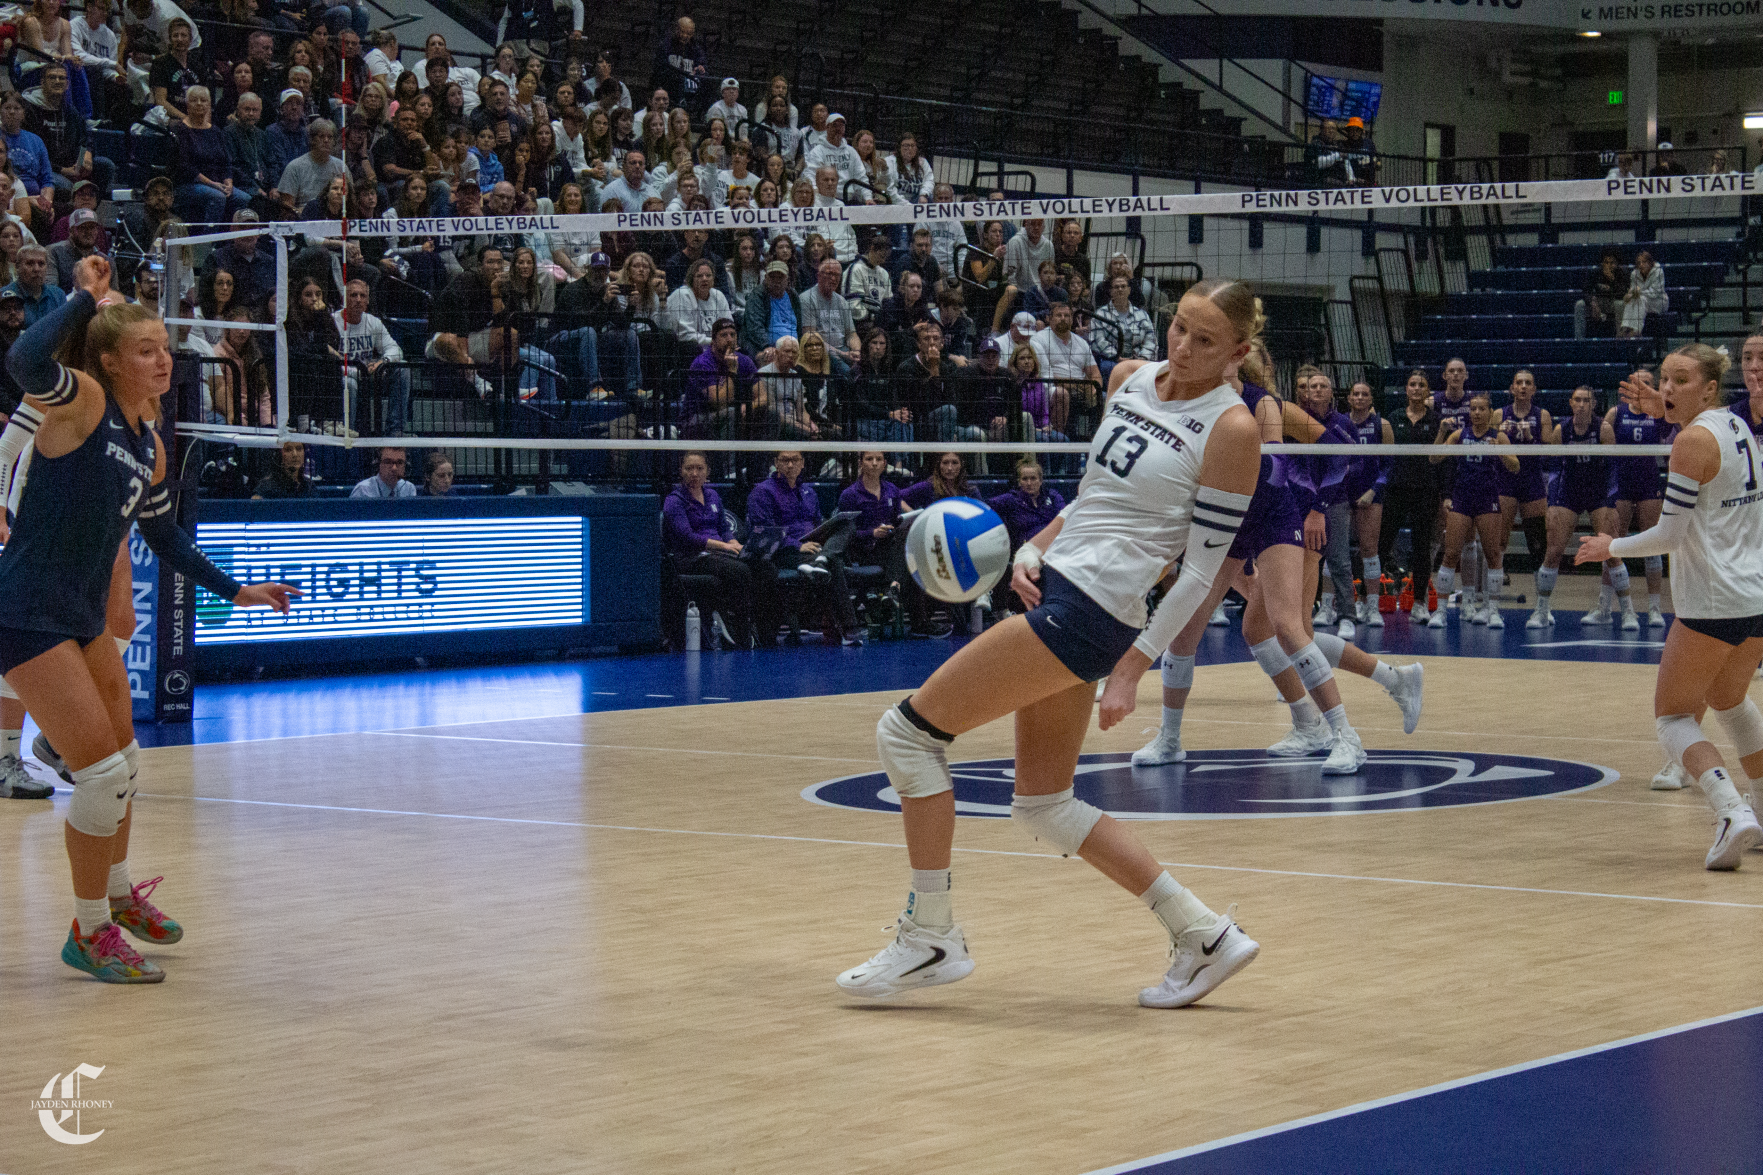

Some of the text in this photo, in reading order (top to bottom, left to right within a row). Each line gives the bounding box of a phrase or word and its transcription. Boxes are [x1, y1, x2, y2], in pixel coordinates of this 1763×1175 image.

[1599, 1, 1761, 20] MEN'S RESTROOM
[1241, 183, 1528, 208] PENN STATE VOLLEYBALL
[1607, 174, 1755, 196] PENN STATE
[618, 207, 850, 228] PENN STATE VOLLEYBALL
[914, 196, 1171, 219] PENN STATE VOLLEYBALL
[348, 215, 560, 233] PENN STATE VOLLEYBALL
[1110, 403, 1186, 453] PENN STATE
[1633, 427, 1643, 442] 6
[105, 441, 137, 471] PENN
[1095, 425, 1149, 479] 13
[1735, 438, 1757, 491] 7
[121, 476, 143, 518] 3
[1294, 529, 1302, 541] N
[247, 560, 438, 603] HEIGHTS
[173, 572, 184, 656] ENN STATE
[127, 581, 153, 700] PENN
[164, 702, 190, 711] REC HALL
